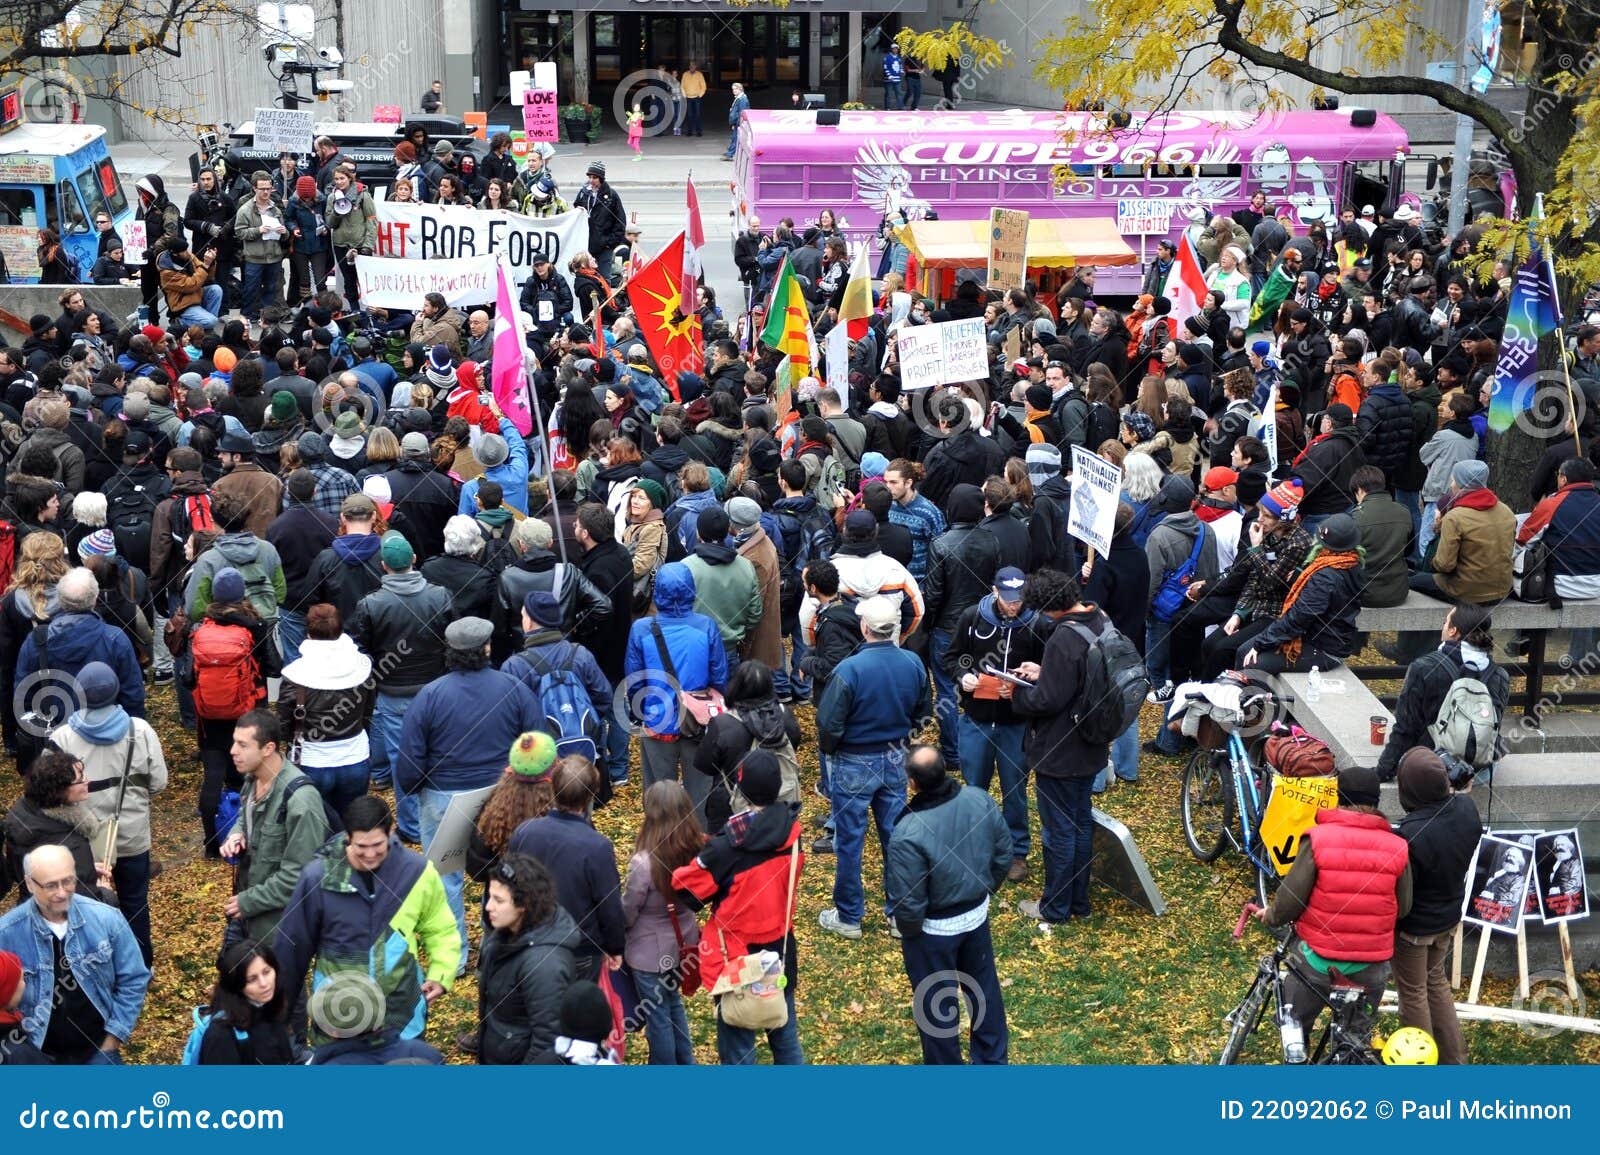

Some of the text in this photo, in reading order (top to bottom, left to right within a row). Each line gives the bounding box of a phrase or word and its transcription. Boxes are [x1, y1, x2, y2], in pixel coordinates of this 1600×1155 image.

[526, 92, 554, 105] LOVE
[258, 110, 310, 120] AUTOMATE
[240, 150, 280, 158] TORONTO'
[919, 168, 1038, 181] FLYING
[0, 228, 29, 236] PECIAL
[1119, 217, 1168, 233] PATRIOTIC
[374, 216, 560, 267] HT ROB FORD
[907, 359, 942, 381] PROFIT
[1076, 453, 1118, 484] NATIONALIZE
[1079, 466, 1090, 481] THE
[1309, 783, 1336, 797] HERE
[1282, 786, 1330, 809] VOTEZ ICI
